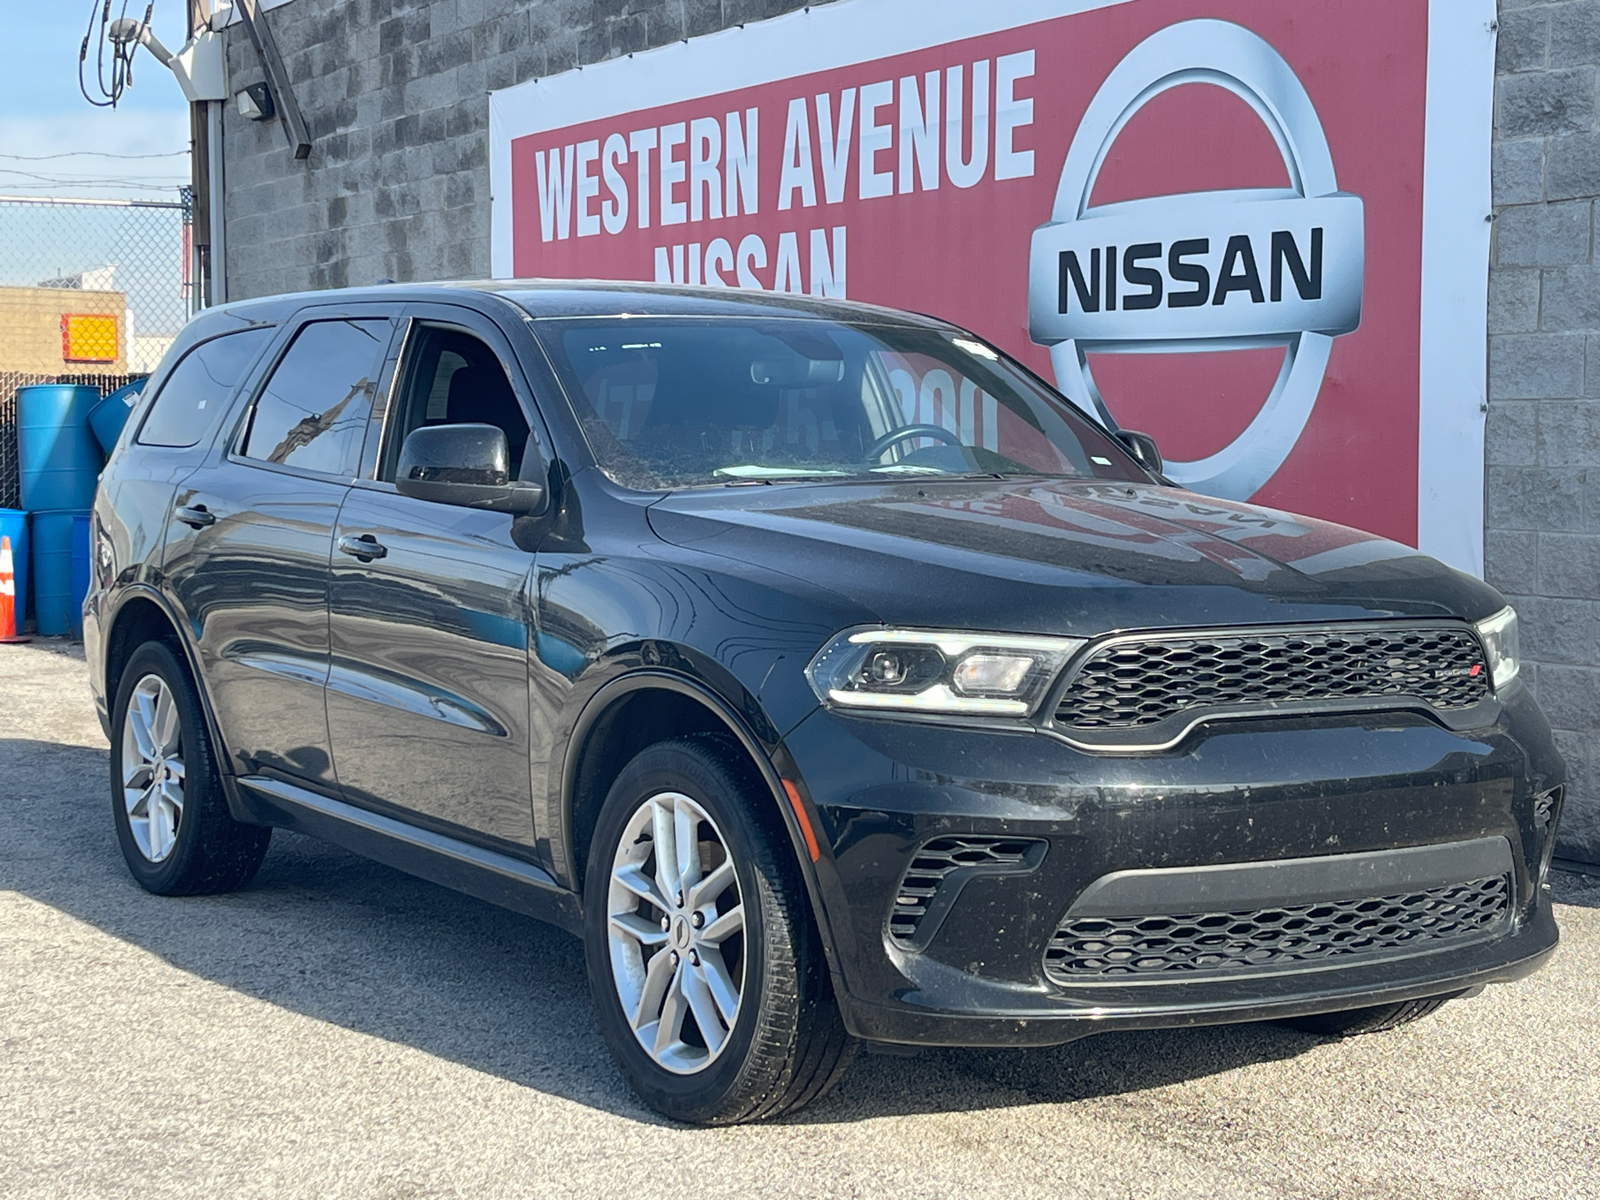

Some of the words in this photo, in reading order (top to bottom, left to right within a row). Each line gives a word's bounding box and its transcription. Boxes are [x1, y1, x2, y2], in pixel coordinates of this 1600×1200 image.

[535, 107, 758, 242] WESTERN
[778, 49, 1035, 211] AVENUE
[1058, 227, 1323, 314] NISSAN
